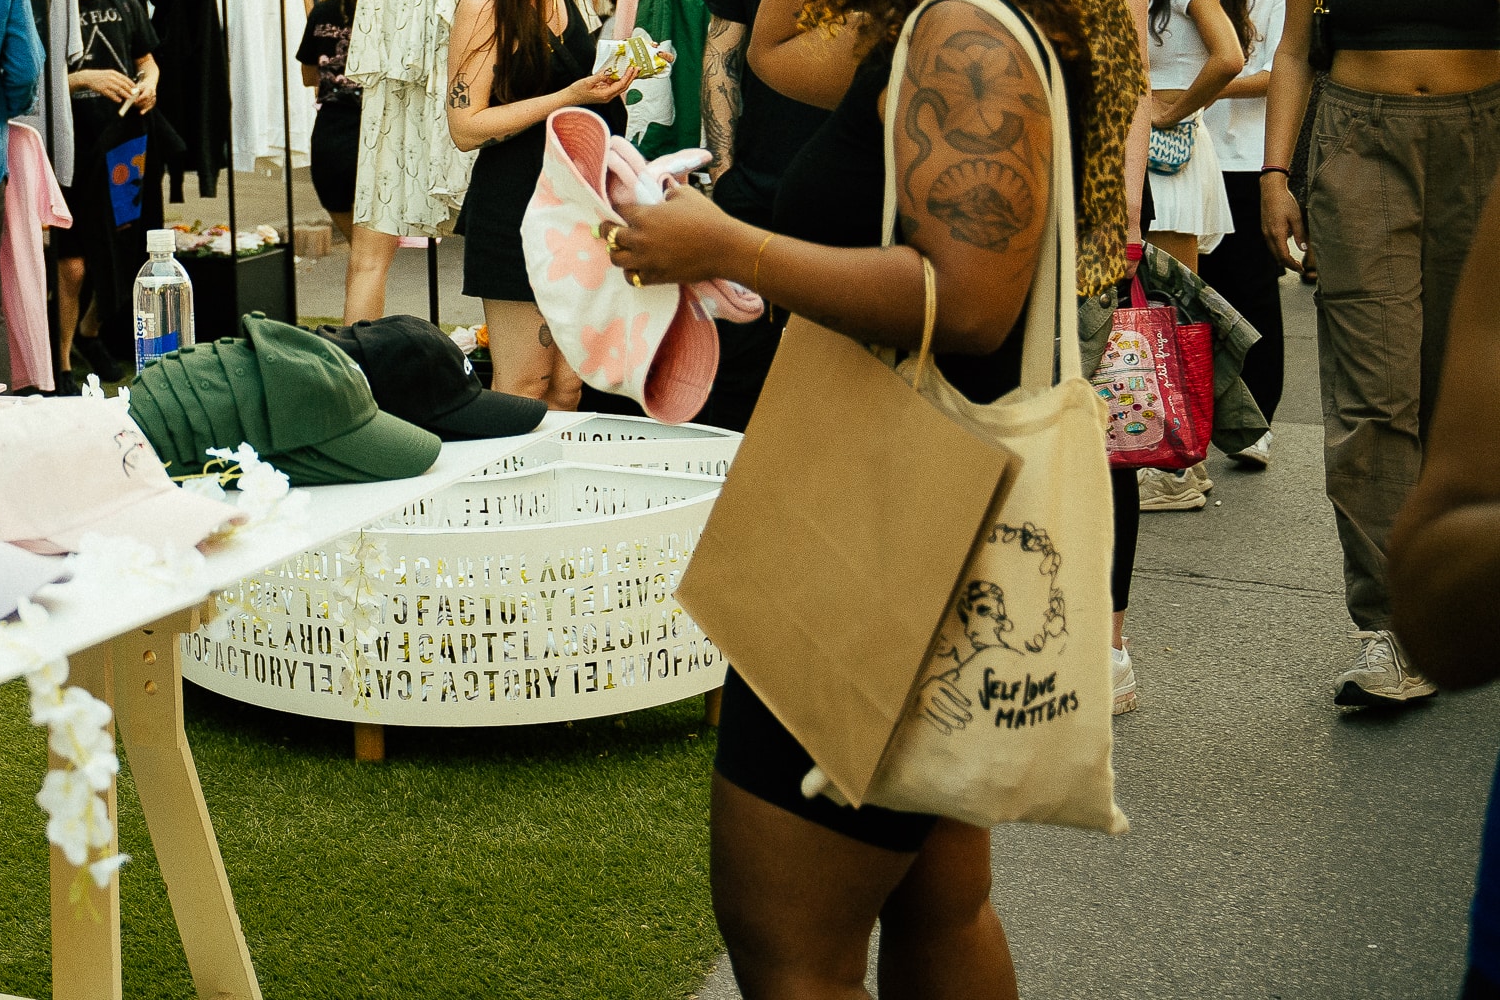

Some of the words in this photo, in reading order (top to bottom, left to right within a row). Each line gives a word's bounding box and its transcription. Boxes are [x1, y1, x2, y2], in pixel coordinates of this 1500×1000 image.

[418, 631, 538, 664] CARTEL
[203, 636, 298, 690] FACTORY
[420, 667, 560, 702] FACTORY
[995, 690, 1079, 730] MATTERS
